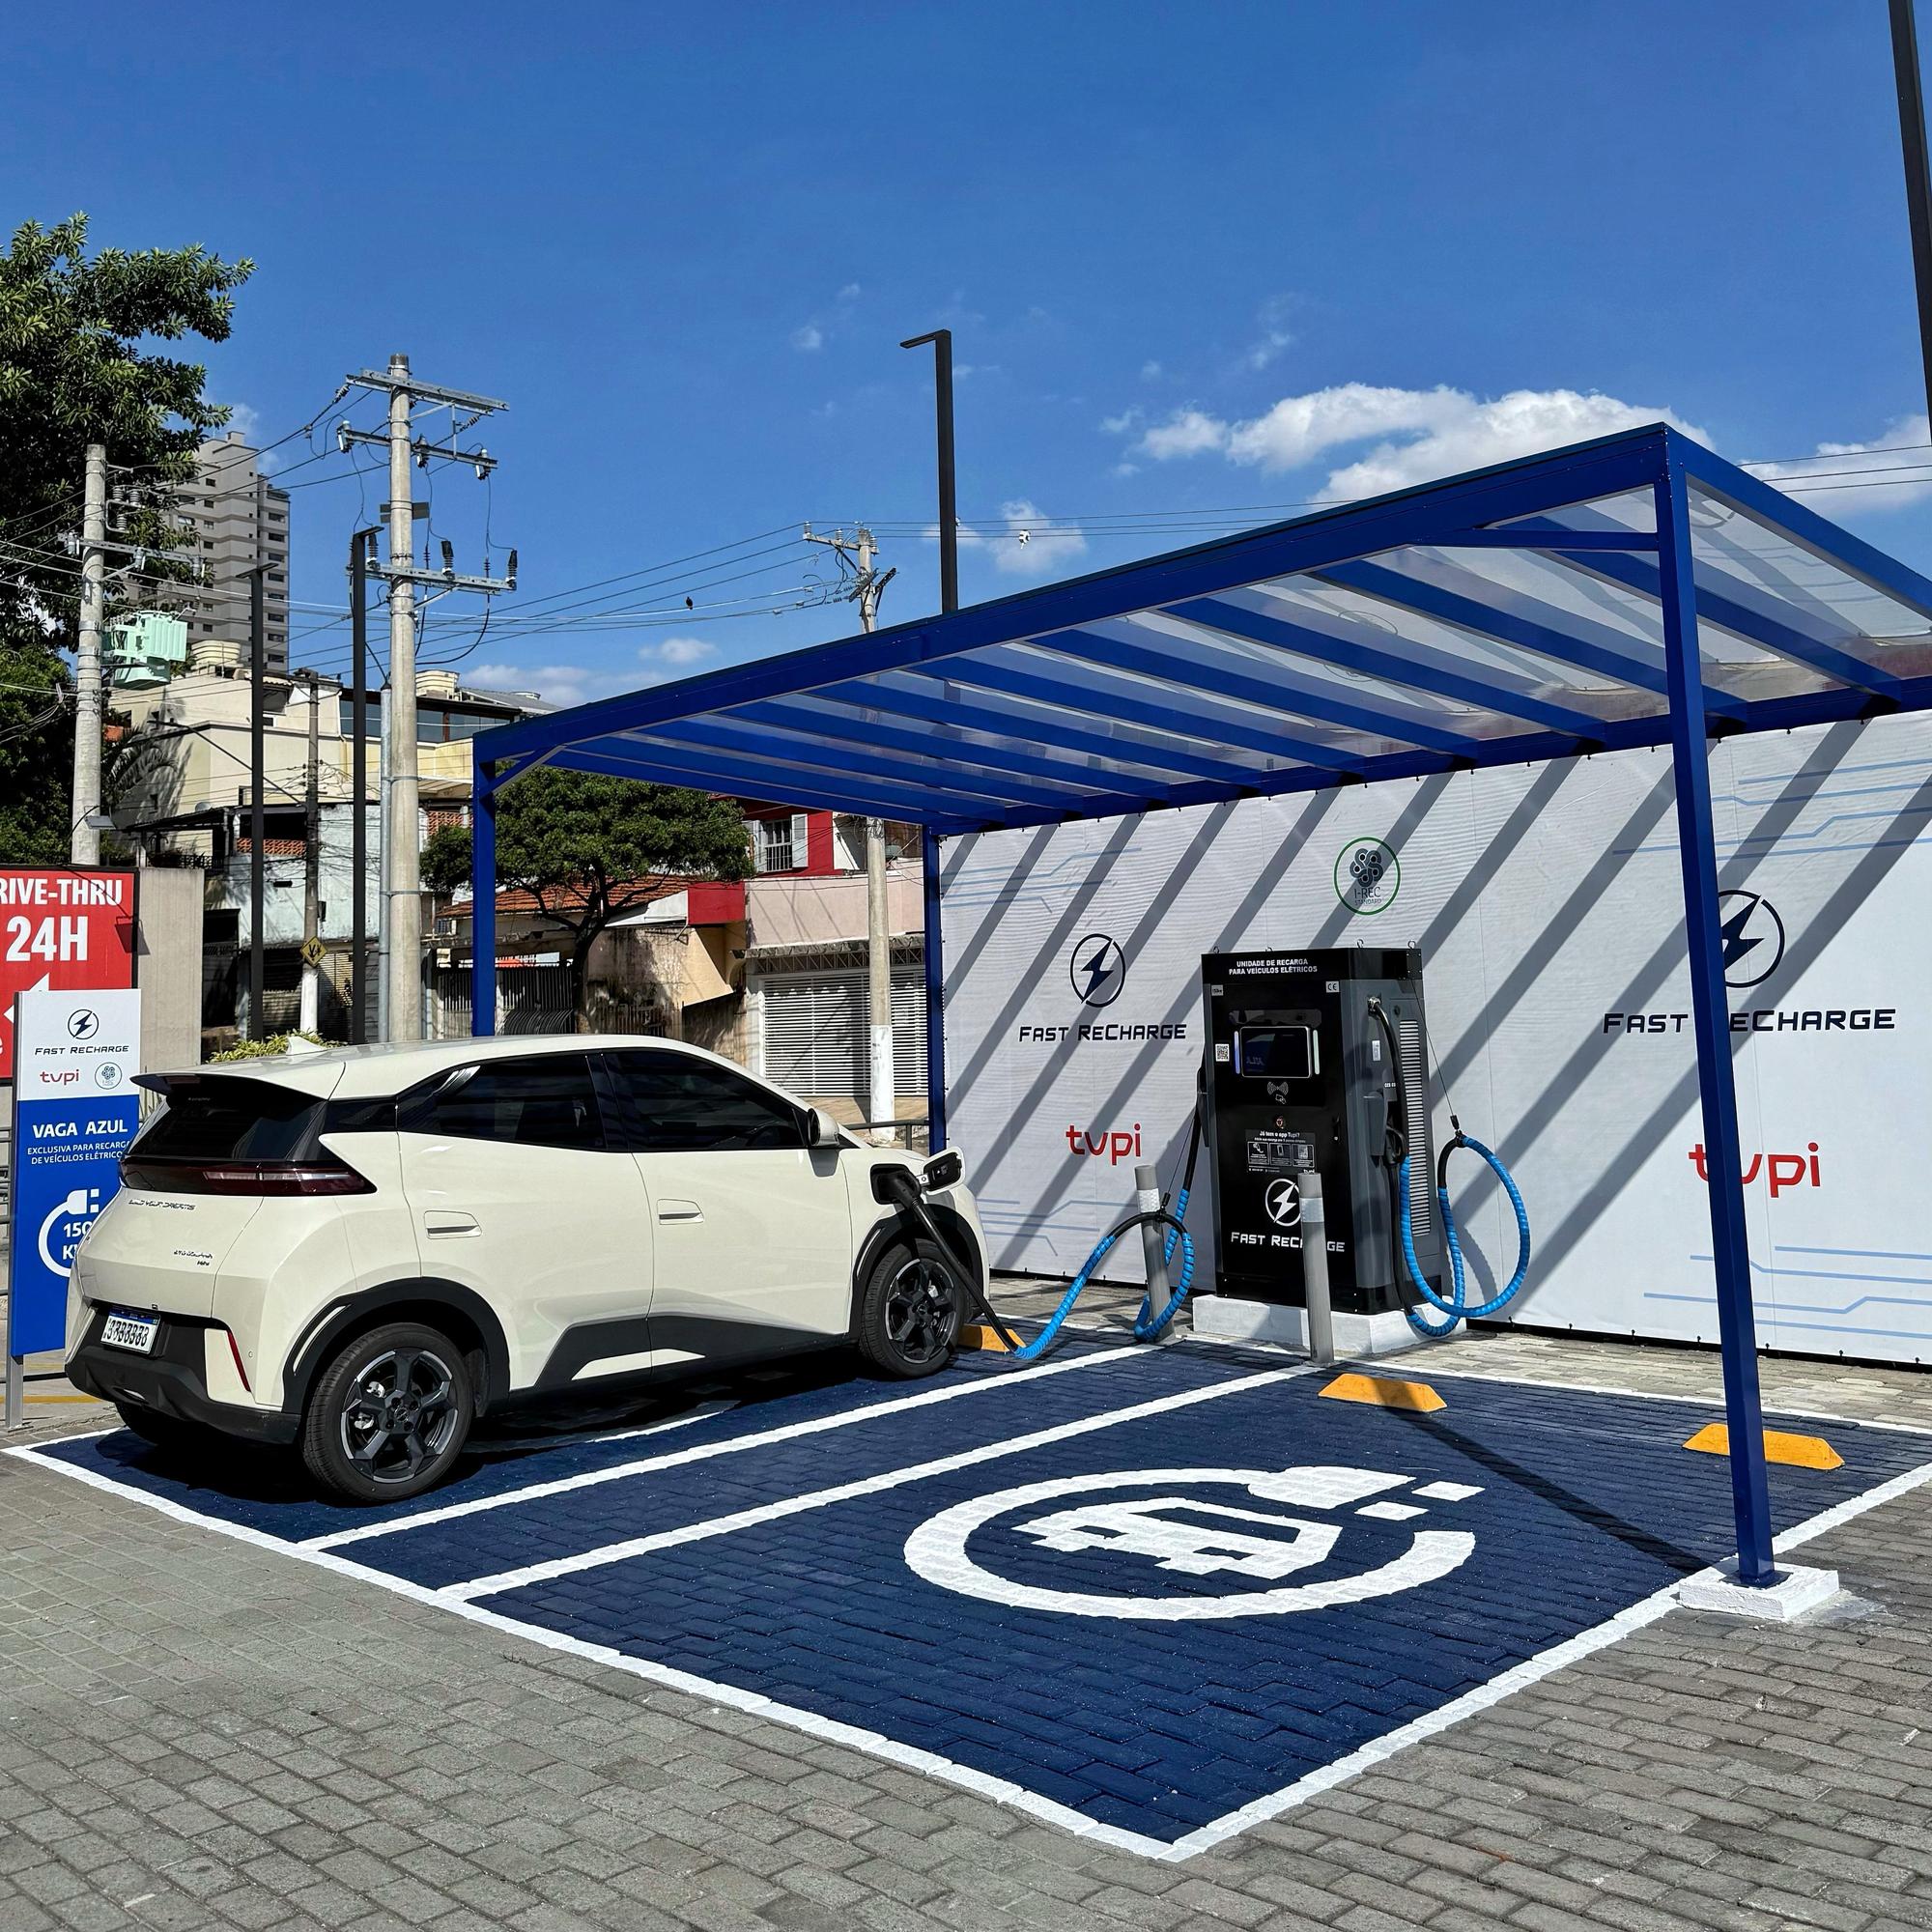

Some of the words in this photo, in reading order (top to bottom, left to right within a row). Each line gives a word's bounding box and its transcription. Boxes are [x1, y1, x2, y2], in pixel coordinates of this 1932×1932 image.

[1354, 887, 1381, 898] I-REC
[6, 915, 89, 962] 24H
[1247, 966, 1279, 975] VEÍCULOS
[1280, 965, 1318, 974] ELÉTRICOS
[1603, 1012, 1689, 1034] FAST
[1729, 1009, 1896, 1033] ECHARGE
[1019, 1027, 1069, 1042] FAST
[35, 1047, 66, 1056] FAST
[33, 1122, 77, 1138] VAGA
[85, 1120, 128, 1135] AZUL
[27, 1144, 71, 1155] EXCLUSIVA
[72, 1143, 94, 1151] PARA
[43, 1153, 84, 1163] VEÍCULOS
[85, 1151, 123, 1160] ELÉTRICO
[63, 1221, 92, 1237] 150
[1231, 1232, 1265, 1245] FAST
[1271, 1236, 1346, 1252] RECGE
